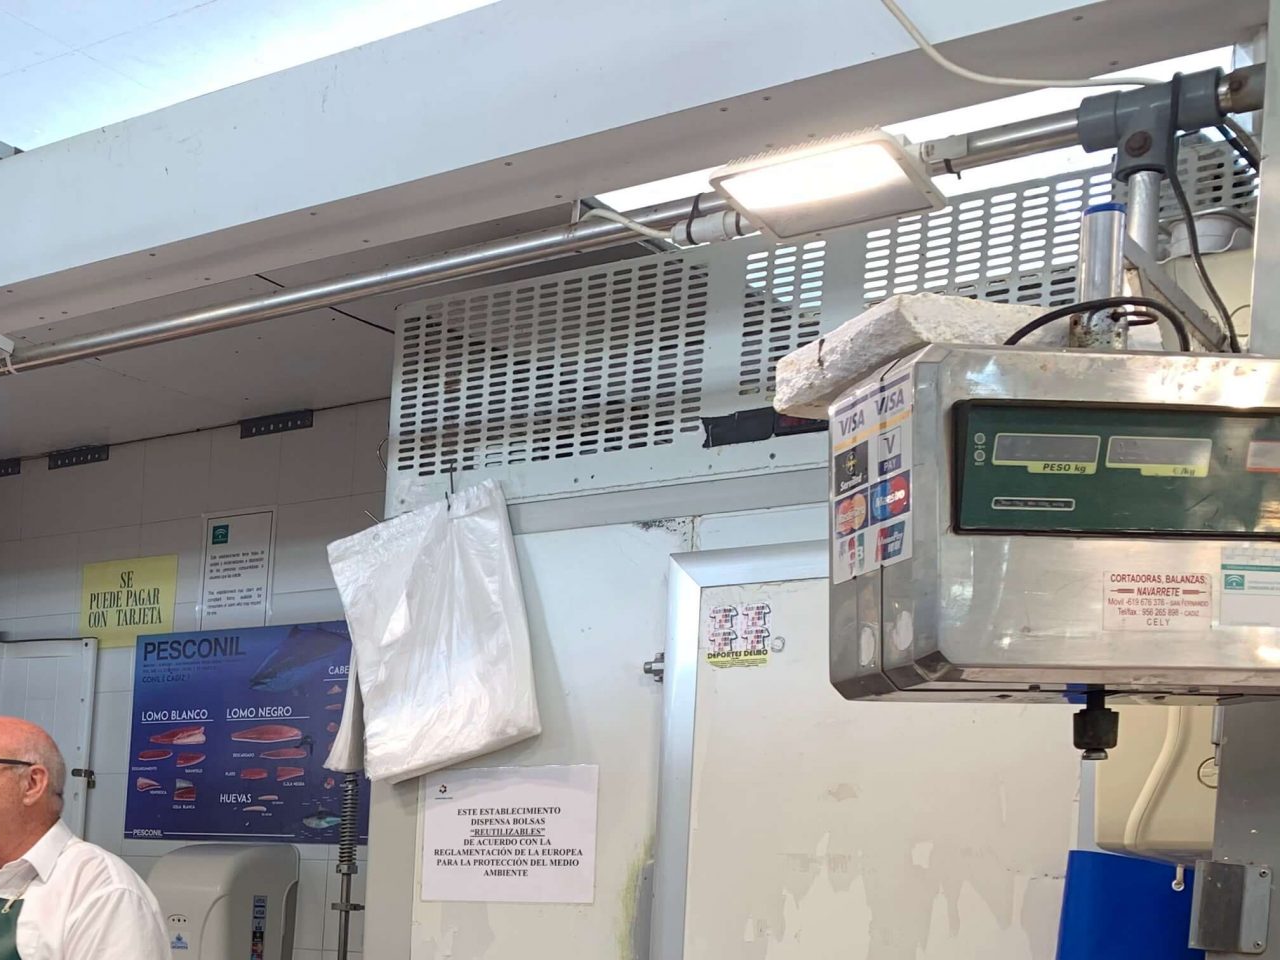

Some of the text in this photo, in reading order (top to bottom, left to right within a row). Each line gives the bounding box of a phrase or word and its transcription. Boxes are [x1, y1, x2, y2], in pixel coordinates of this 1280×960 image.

[874, 388, 905, 416] VISA
[838, 409, 865, 437] VISA
[883, 460, 898, 472] PAY
[1042, 462, 1087, 474] PESO kg
[119, 570, 134, 588] SE
[1136, 587, 1181, 597] NAVARRETE
[89, 587, 160, 610] PUEDE PAGAR
[88, 606, 162, 628] CON TARJETA
[143, 636, 247, 661] PESCONIL
[328, 665, 350, 675] CABE
[141, 709, 209, 721] LOMO BLANCO
[226, 706, 293, 719] LOMO NEGRO
[219, 793, 252, 804] HUEVAS
[457, 806, 561, 816] ESTE ESTABLECIMIENTO
[470, 817, 546, 826] DISPENSA BOLSAS
[463, 838, 552, 846] DE ACUERDO CON LA
[434, 846, 583, 857] REGLAMENTACIÓN DE LA EUROPEA
[436, 859, 458, 867] PARA
[460, 859, 471, 867] LA
[530, 859, 548, 867] DEL
[549, 859, 580, 867] MEDIO
[483, 869, 529, 877] AMBIENTE
